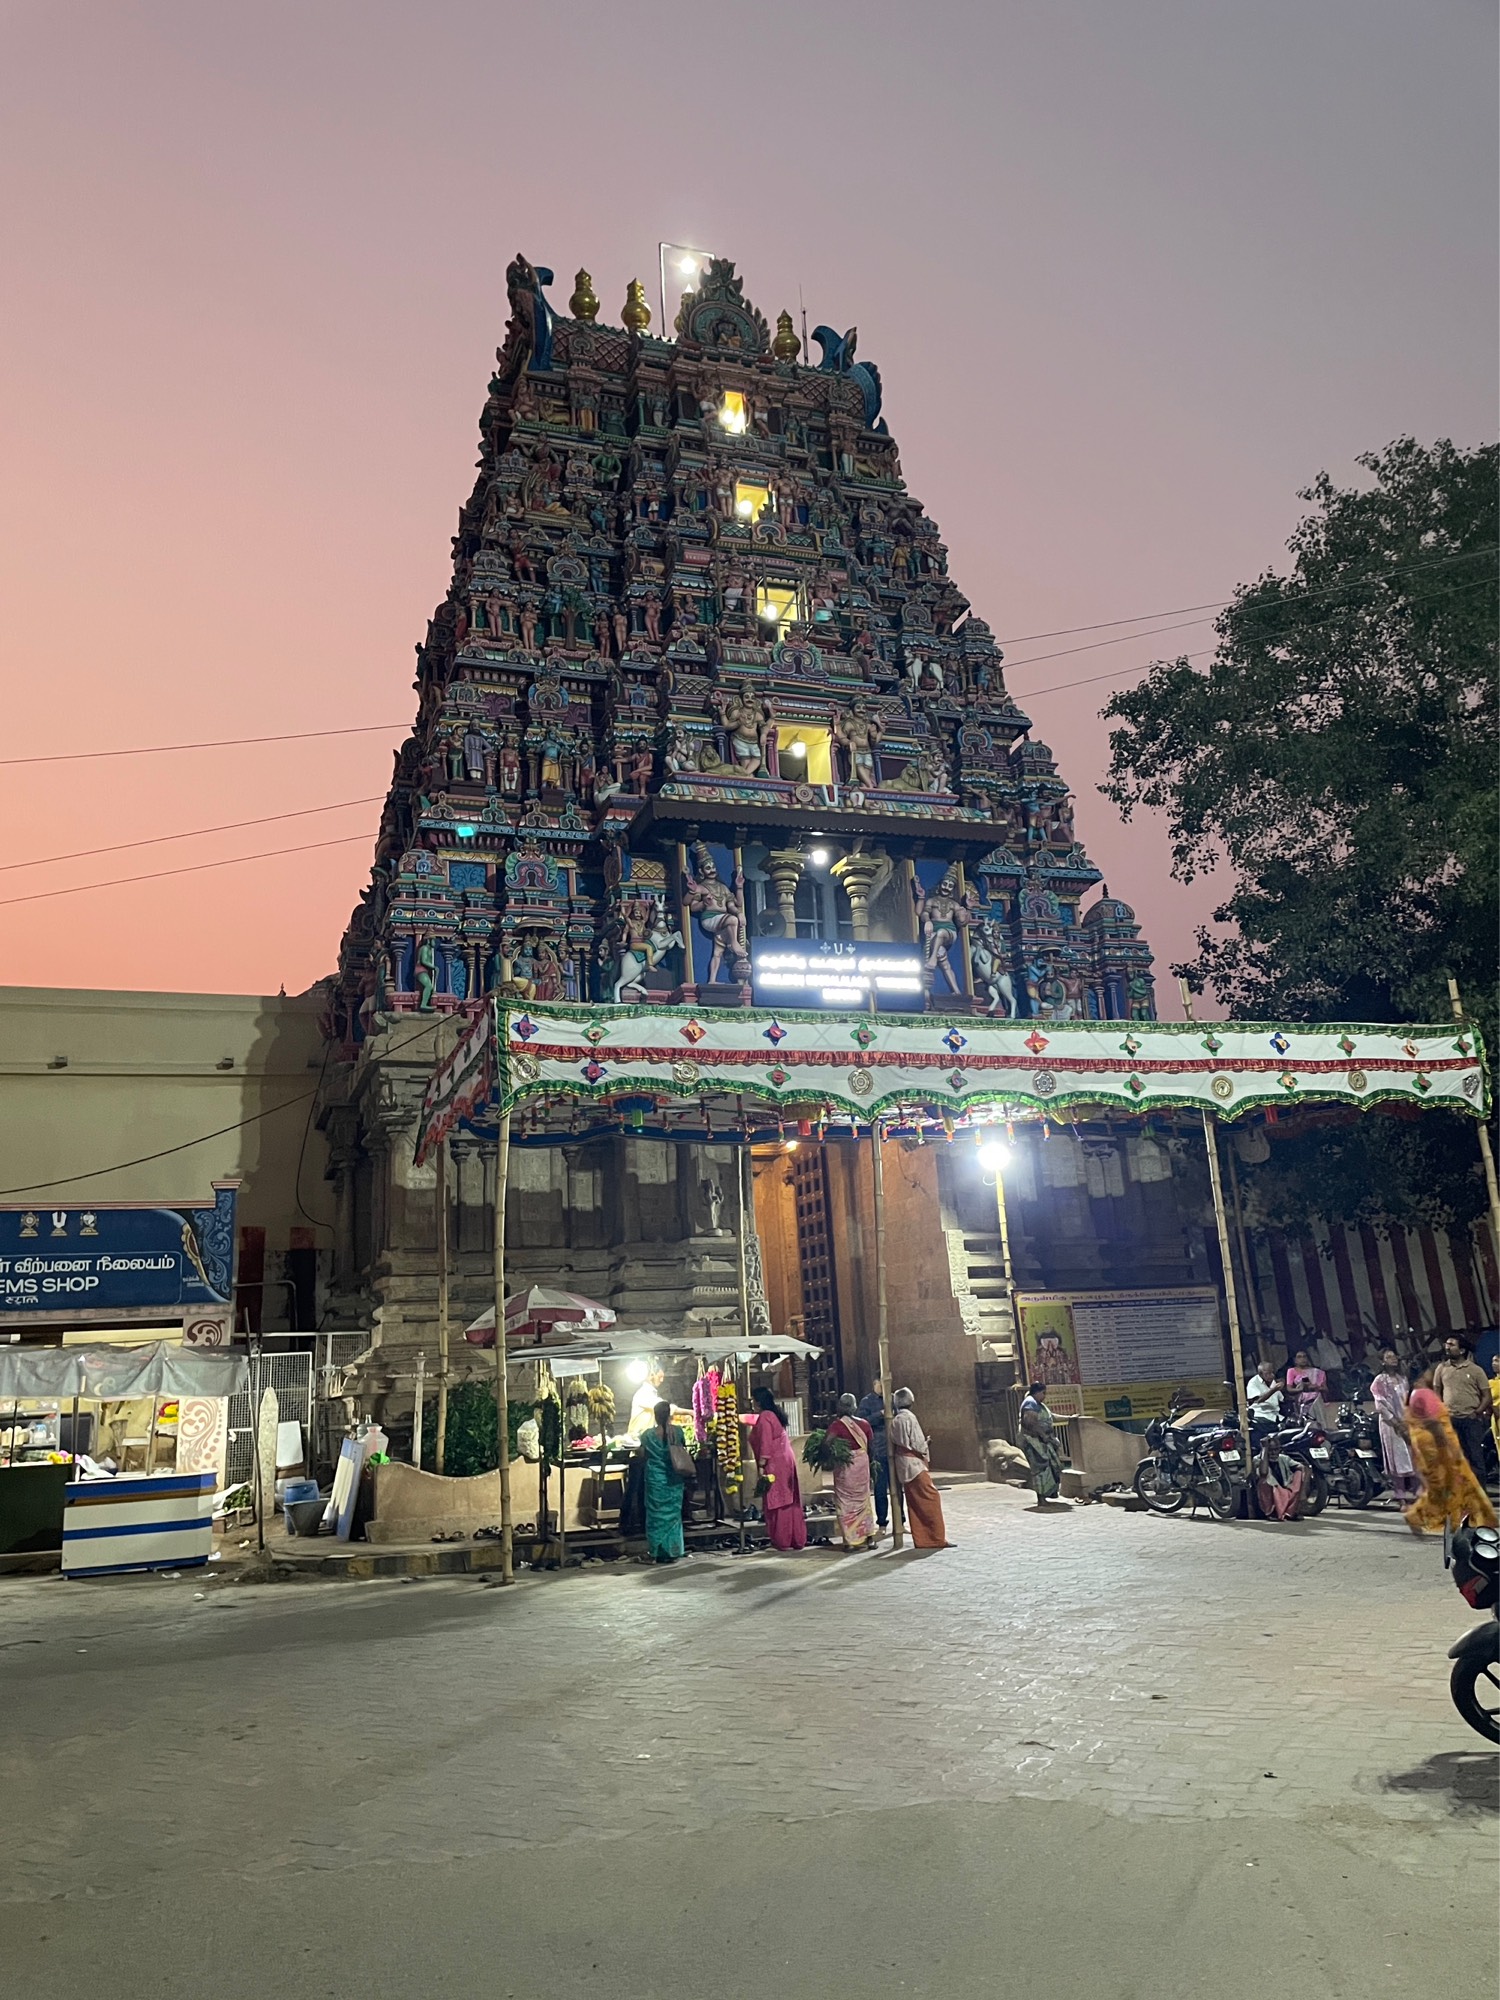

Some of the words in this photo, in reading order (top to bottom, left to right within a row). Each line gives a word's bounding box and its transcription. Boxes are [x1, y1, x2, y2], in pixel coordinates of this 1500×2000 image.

[14, 1256, 92, 1275] விற்பனை
[96, 1254, 175, 1271] நிலையம்
[42, 1276, 99, 1293] SHOP
